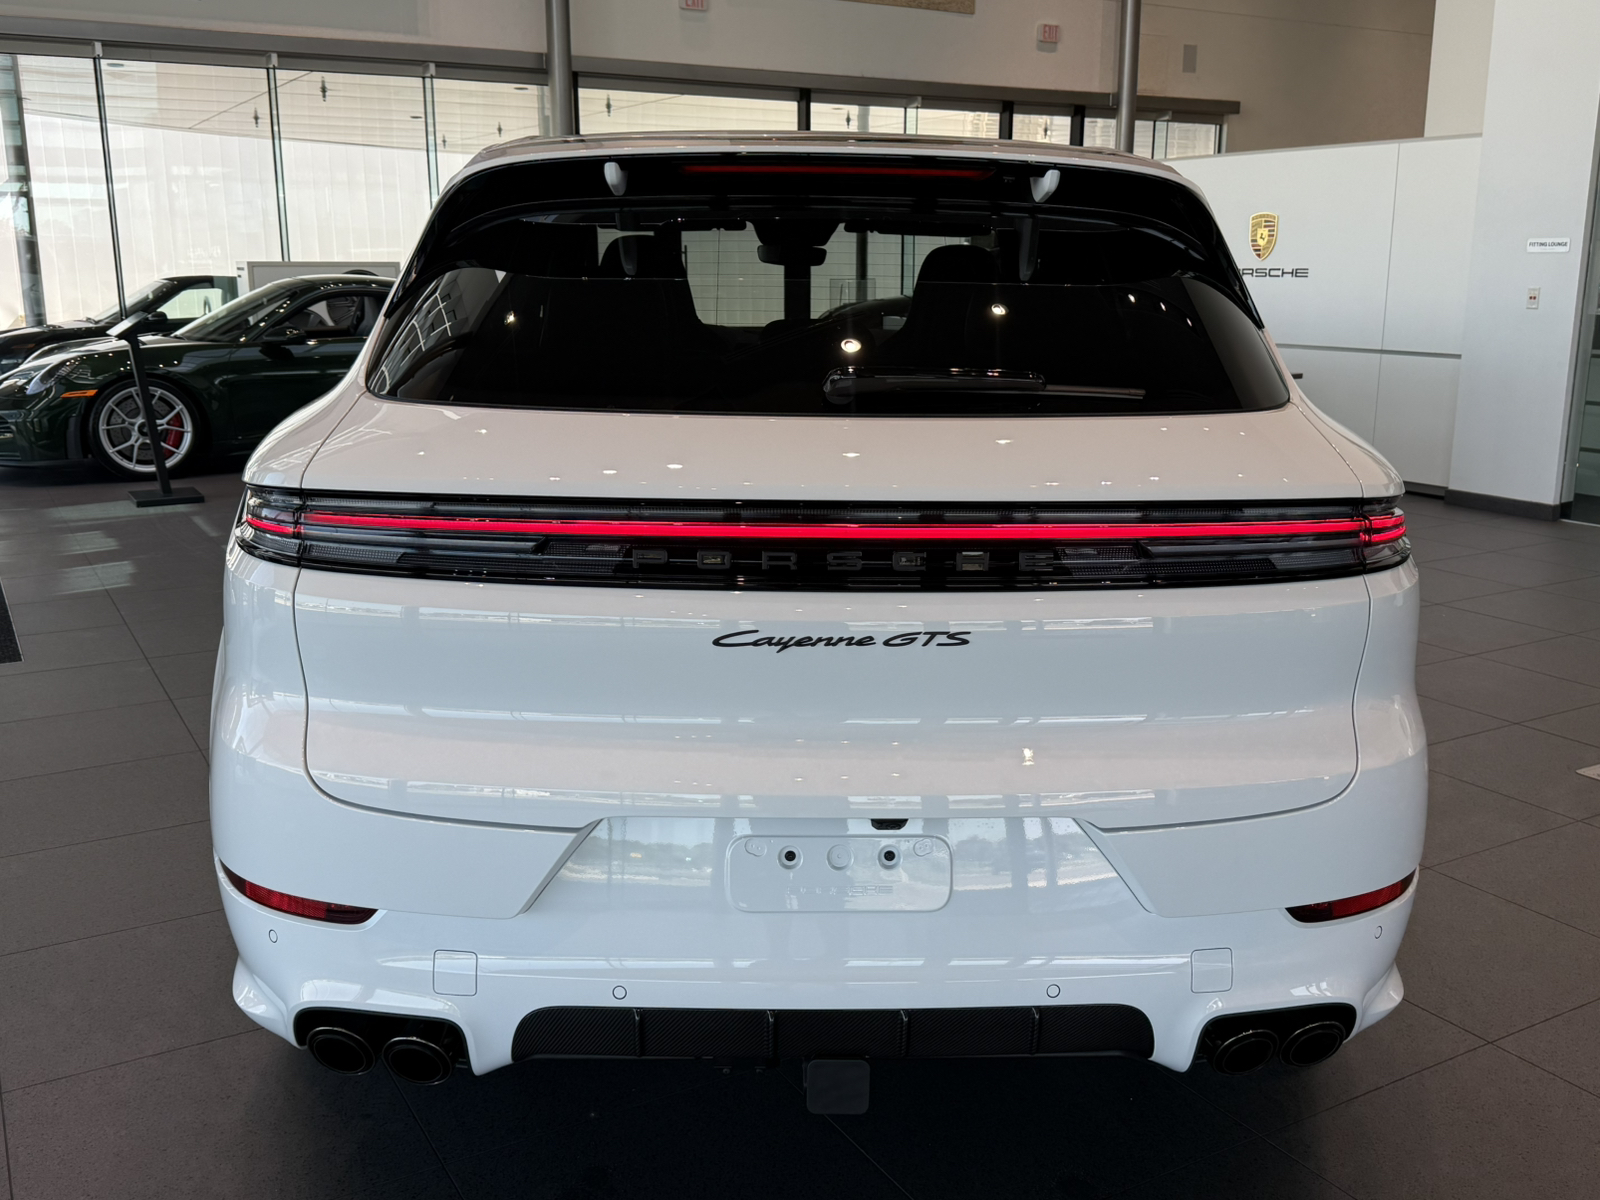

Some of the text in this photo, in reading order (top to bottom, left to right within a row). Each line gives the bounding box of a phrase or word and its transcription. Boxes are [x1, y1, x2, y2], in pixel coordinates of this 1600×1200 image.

[1042, 24, 1059, 42] EXIT
[1239, 268, 1309, 278] RSCHE
[632, 549, 1054, 572] PORSCHE
[711, 629, 972, 653] Cayenne GTS
